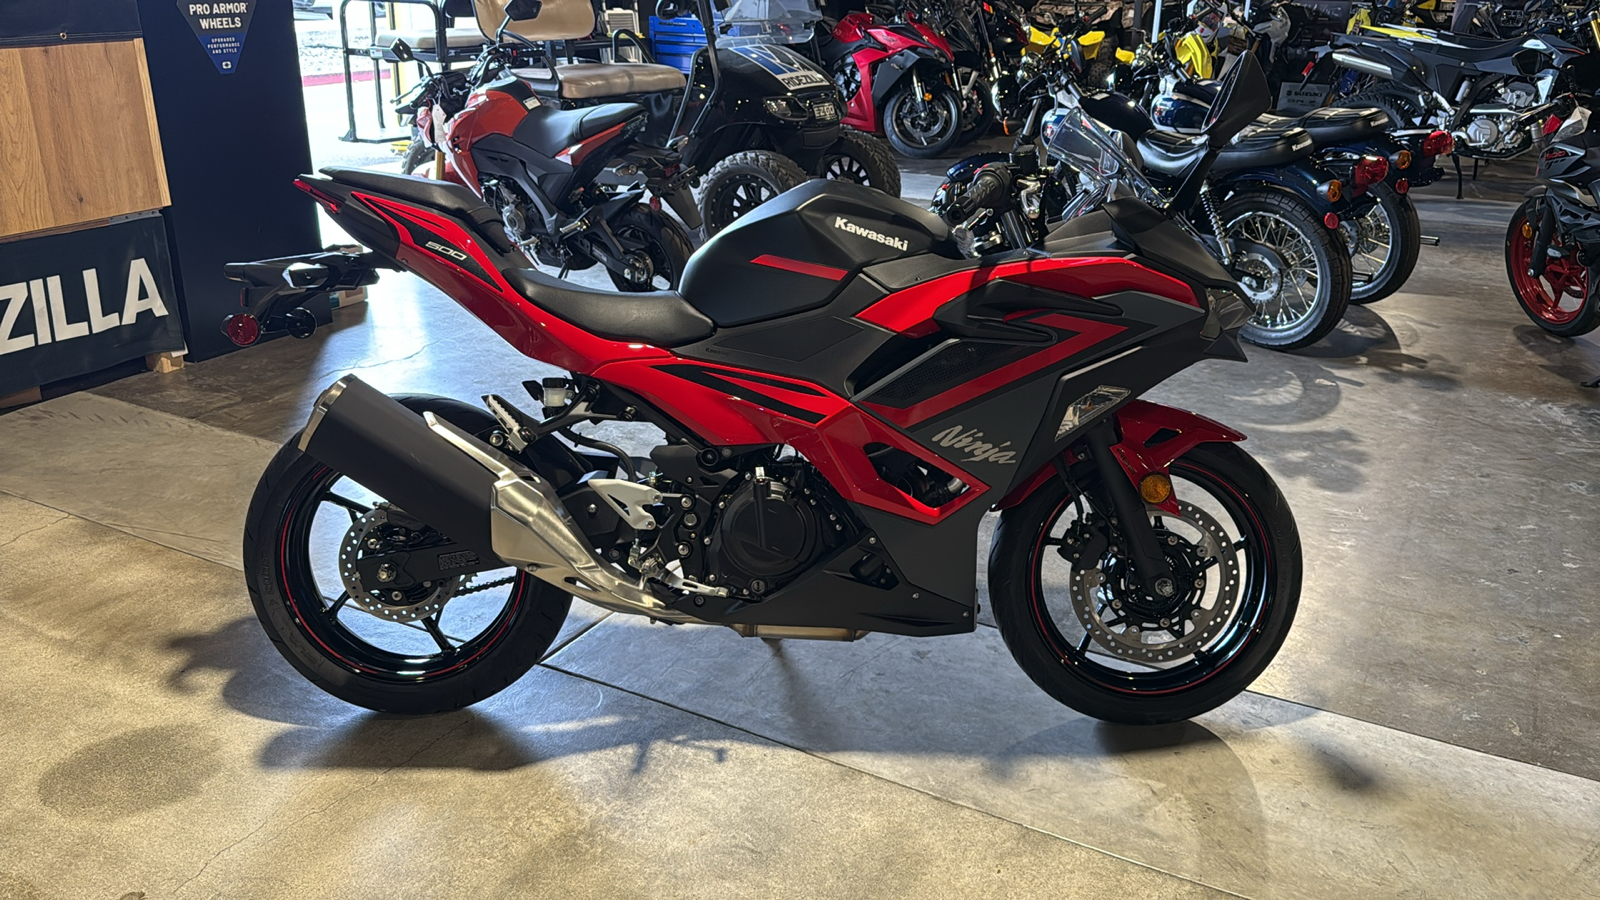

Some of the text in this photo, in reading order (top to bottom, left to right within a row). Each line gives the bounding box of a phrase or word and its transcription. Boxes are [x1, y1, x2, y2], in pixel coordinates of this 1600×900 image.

[189, 2, 247, 15] PRO ARMOR
[199, 17, 241, 30] WHEELS
[834, 216, 909, 252] Kawasaki
[425, 241, 467, 261] 500
[0, 258, 169, 356] ZILLA
[931, 425, 1017, 464] Ninja
